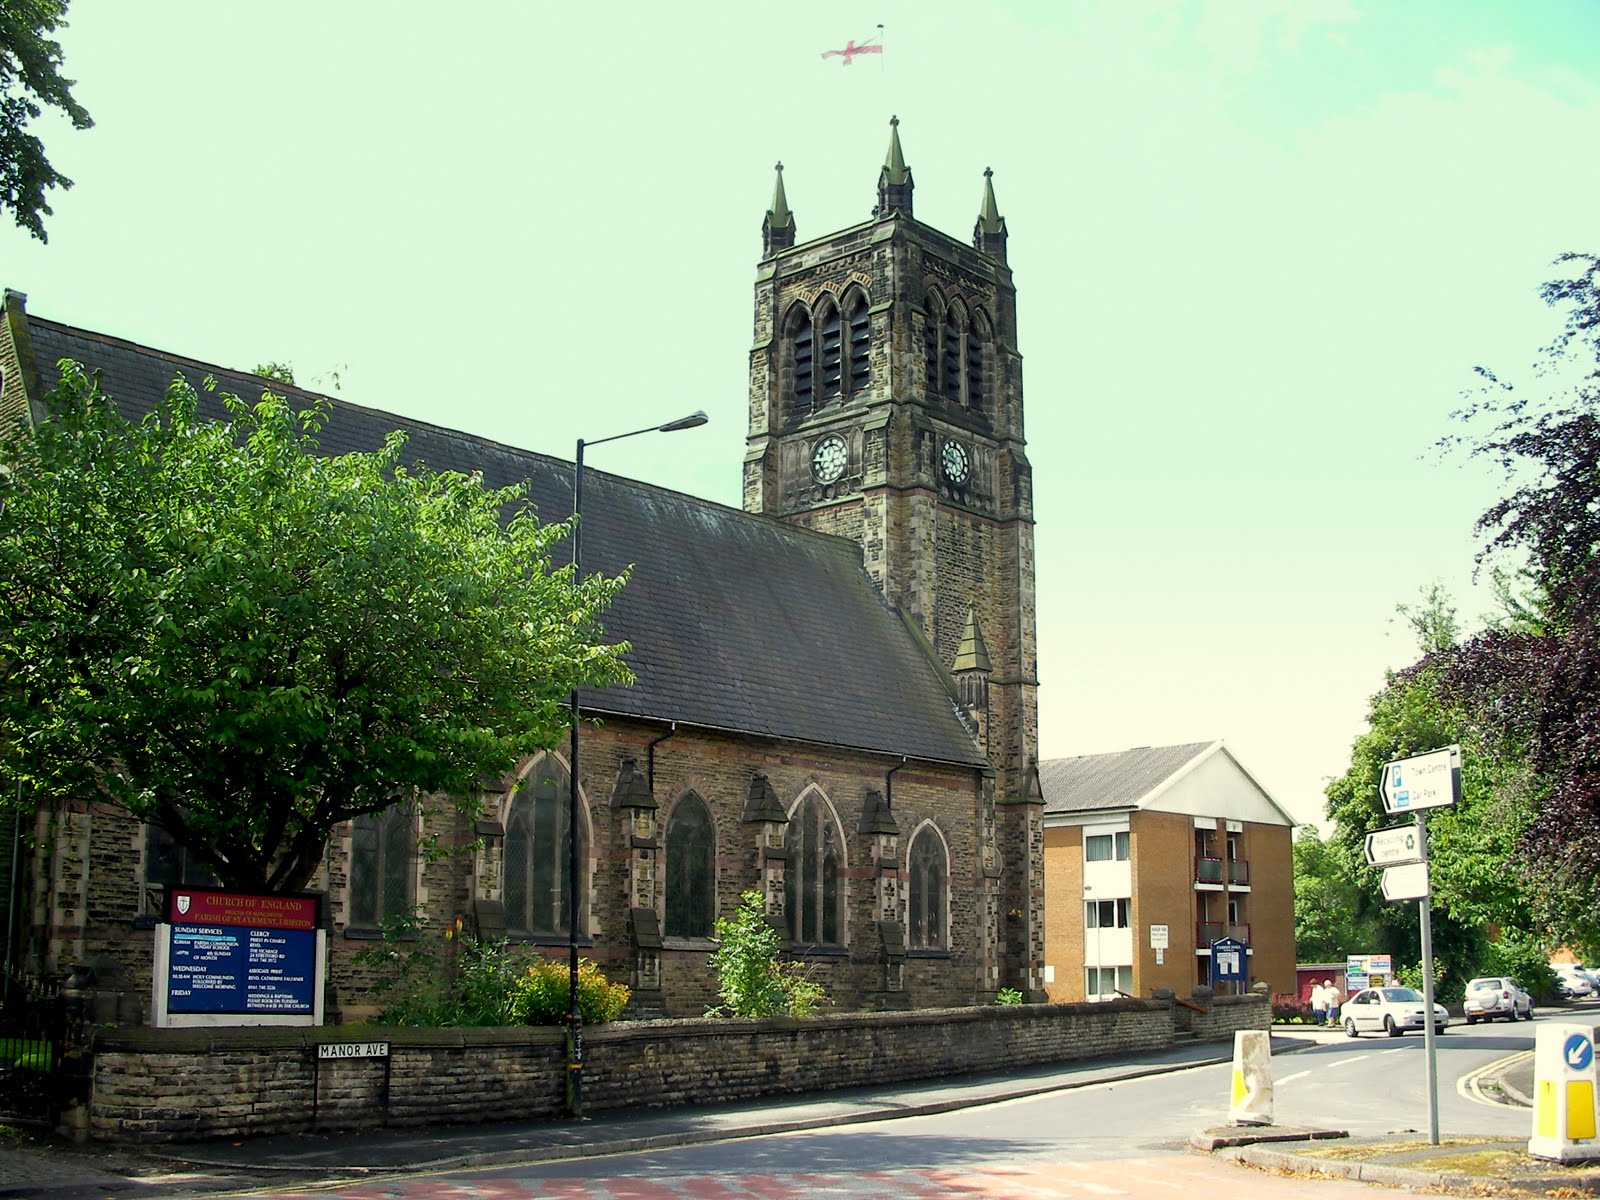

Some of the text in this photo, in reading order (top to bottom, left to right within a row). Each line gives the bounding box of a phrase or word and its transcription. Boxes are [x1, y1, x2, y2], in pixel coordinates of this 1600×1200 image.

[206, 896, 302, 911] CHURCH OF ENGLAND
[194, 913, 222, 921] PARISH
[279, 918, 311, 926] URMSTON
[321, 1044, 384, 1057] MANOR AVE
